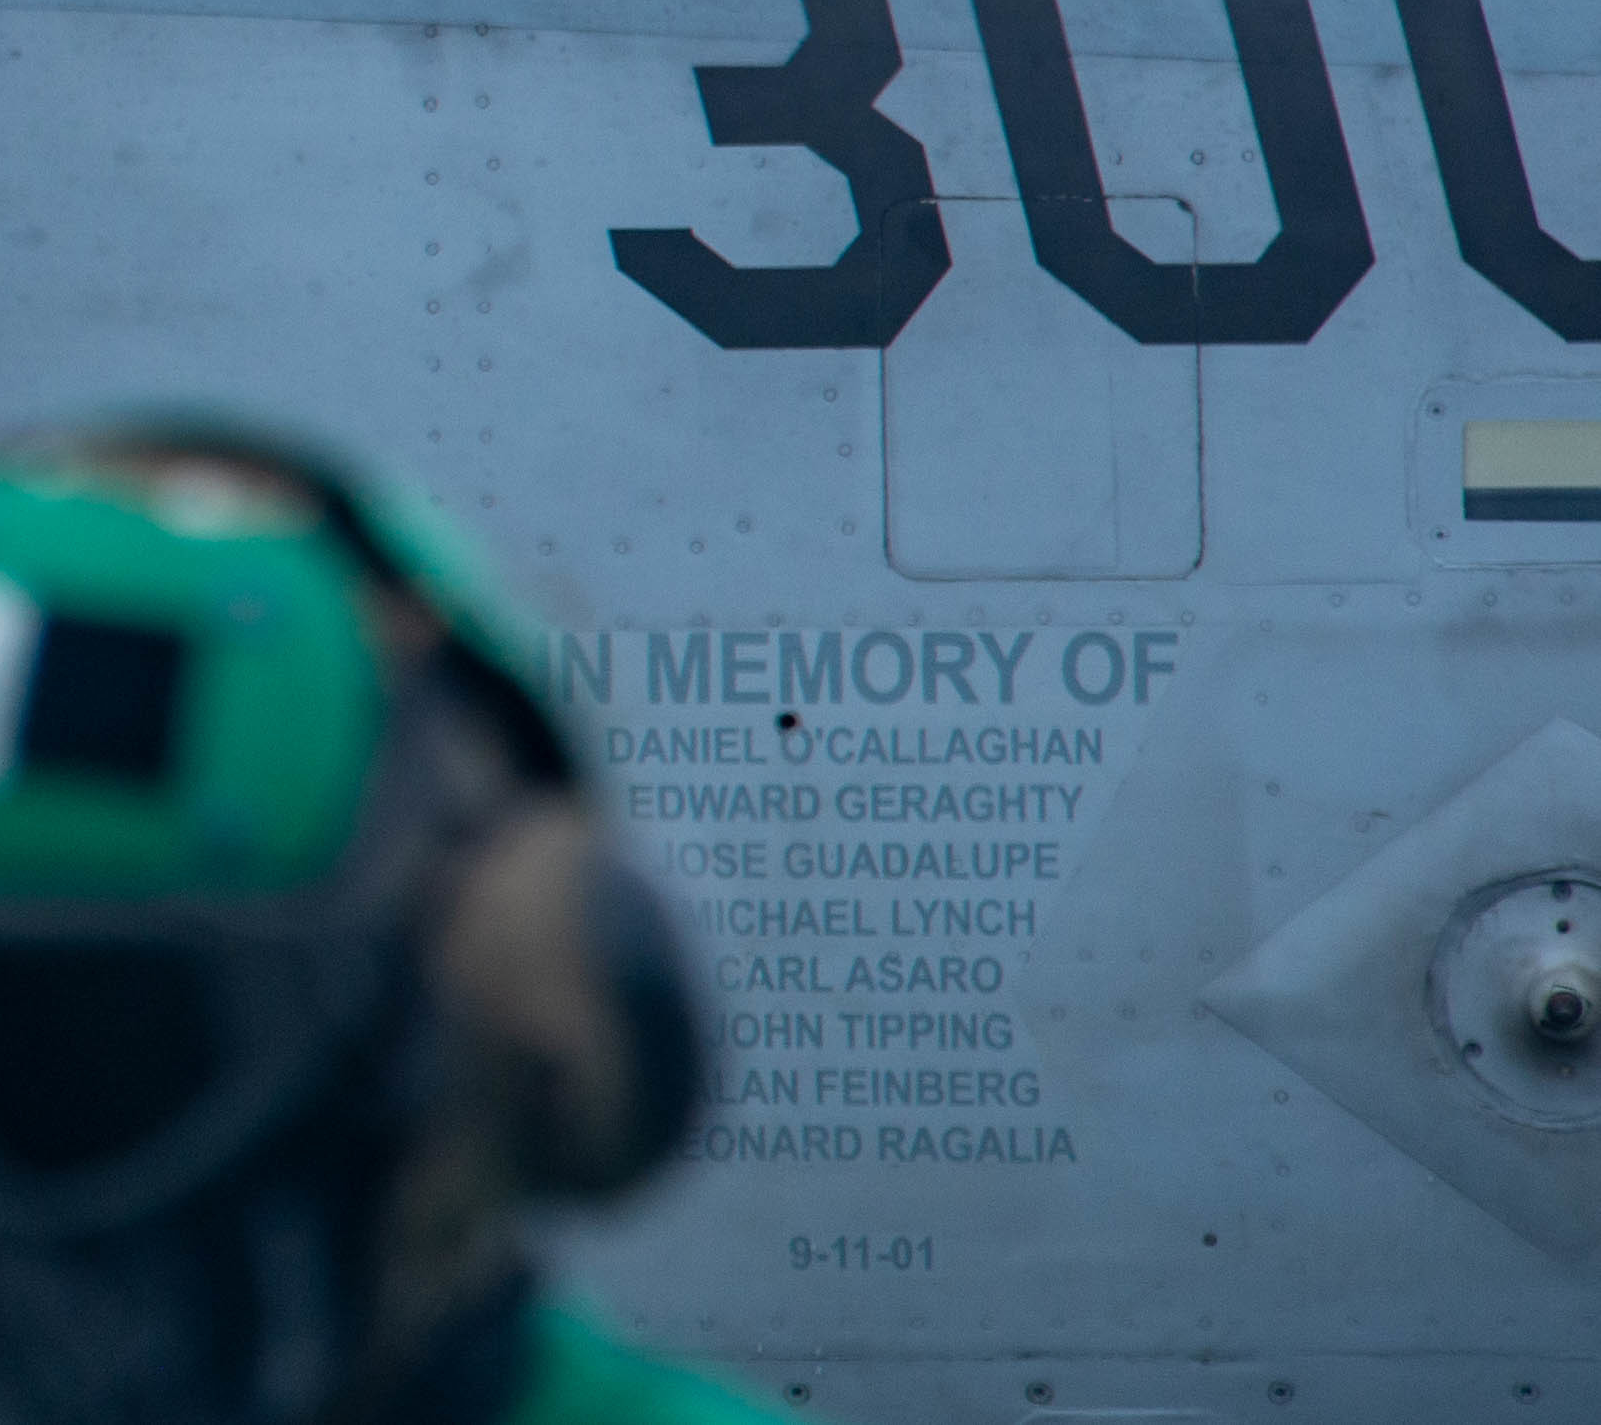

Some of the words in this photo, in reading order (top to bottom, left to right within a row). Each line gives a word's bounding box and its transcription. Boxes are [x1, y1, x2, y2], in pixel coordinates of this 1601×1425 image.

[647, 631, 1034, 705] MEMORY
[1061, 631, 1178, 707] OF
[607, 728, 766, 765] DANIEL
[779, 727, 1103, 766] O'CALLAGHAN
[629, 784, 820, 822] EDWARD
[834, 784, 1083, 823] GERAGHTY
[783, 842, 1060, 881] GUADALUPE
[890, 899, 1036, 937] LYNCH
[716, 956, 832, 993] CARL
[844, 955, 1002, 994] ASARO
[839, 1013, 1014, 1051] TIPPING
[815, 1069, 1040, 1109] FEINBERG
[680, 1126, 862, 1164] EONARD
[878, 1126, 1075, 1165] RAGALIA
[788, 1237, 935, 1271] 9-11-01
